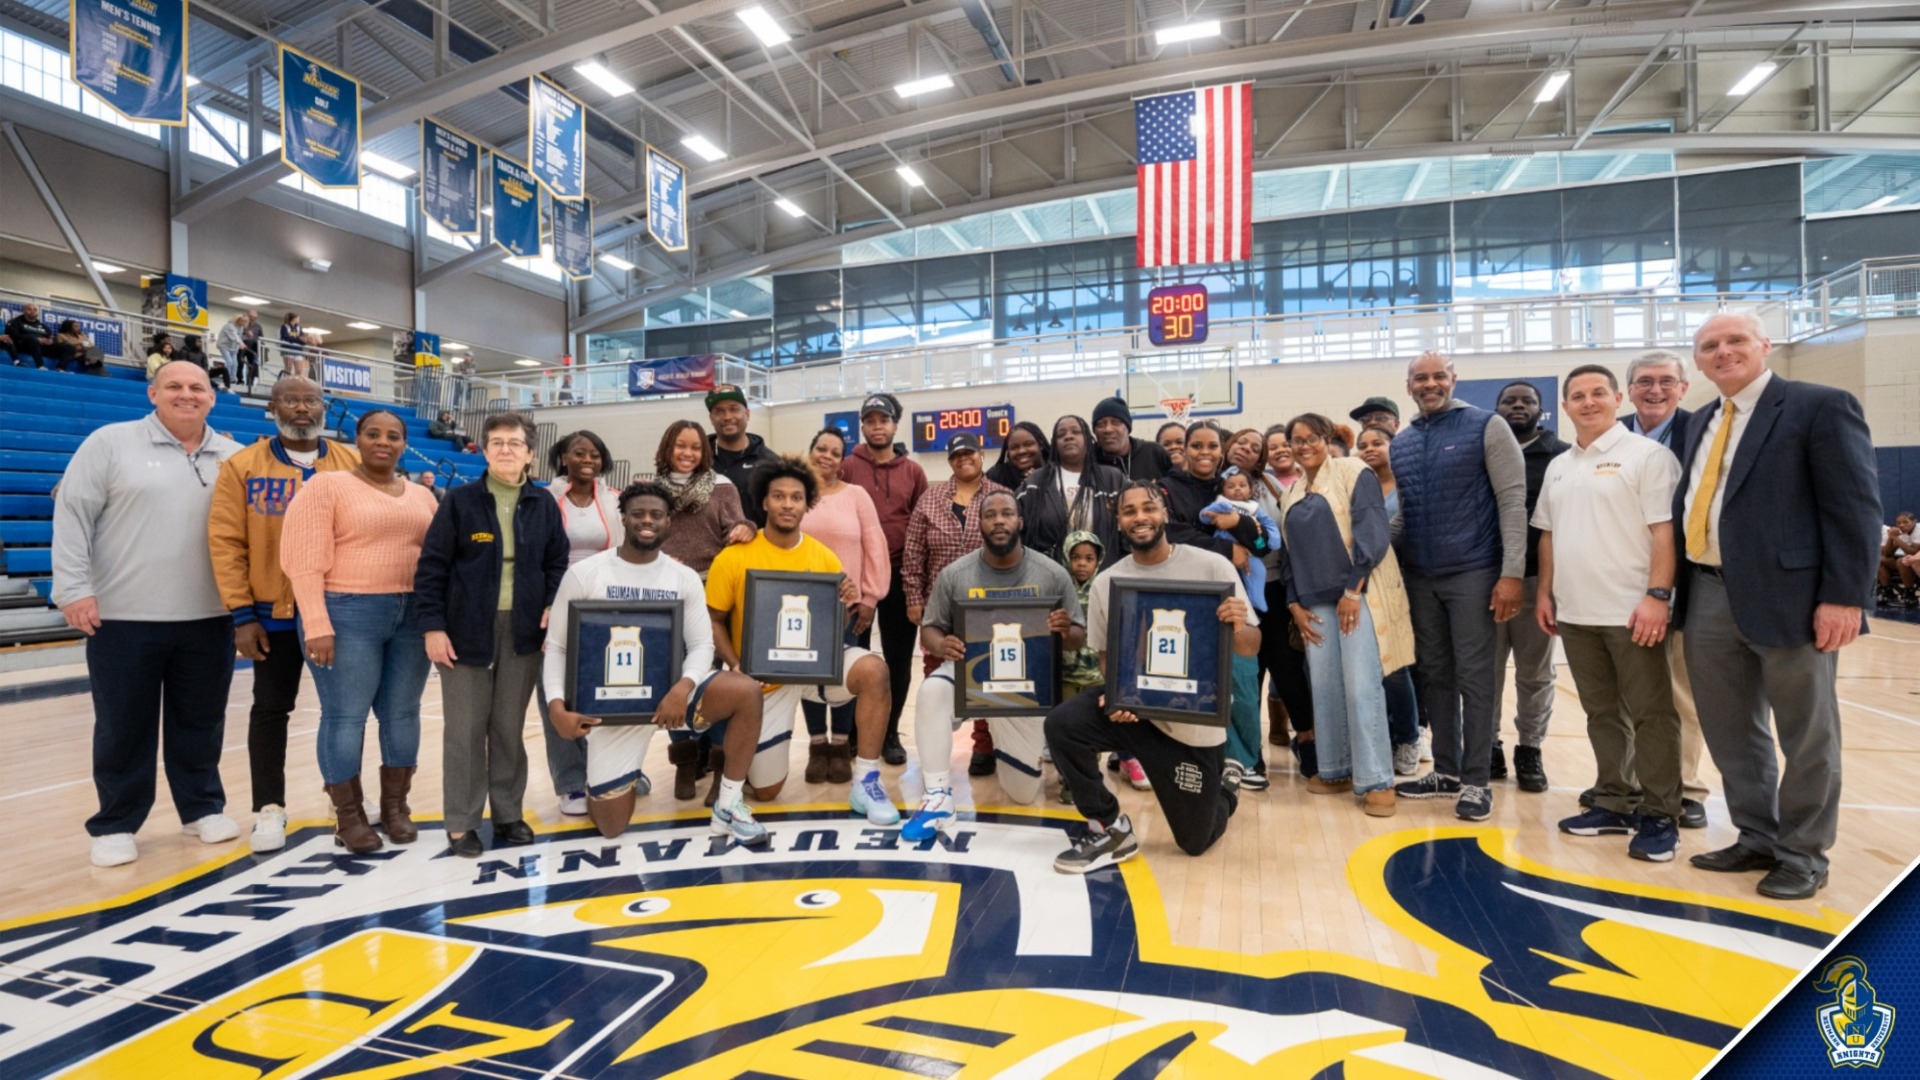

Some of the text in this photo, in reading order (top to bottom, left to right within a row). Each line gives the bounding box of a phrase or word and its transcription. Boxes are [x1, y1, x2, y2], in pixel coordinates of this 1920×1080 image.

[100, 0, 130, 21] MEN'S
[131, 14, 161, 36] TENNIS
[1152, 293, 1204, 314] 20:00
[1165, 315, 1193, 339] 30
[325, 364, 370, 388] VISITOR
[940, 409, 981, 429] 20:00
[926, 418, 1009, 441] 0 0
[606, 585, 678, 601] NEUMANN UNIVERSITY
[787, 618, 802, 631] 13
[1000, 649, 1016, 661] 15
[1158, 638, 1176, 654] 21
[617, 652, 632, 666] 11
